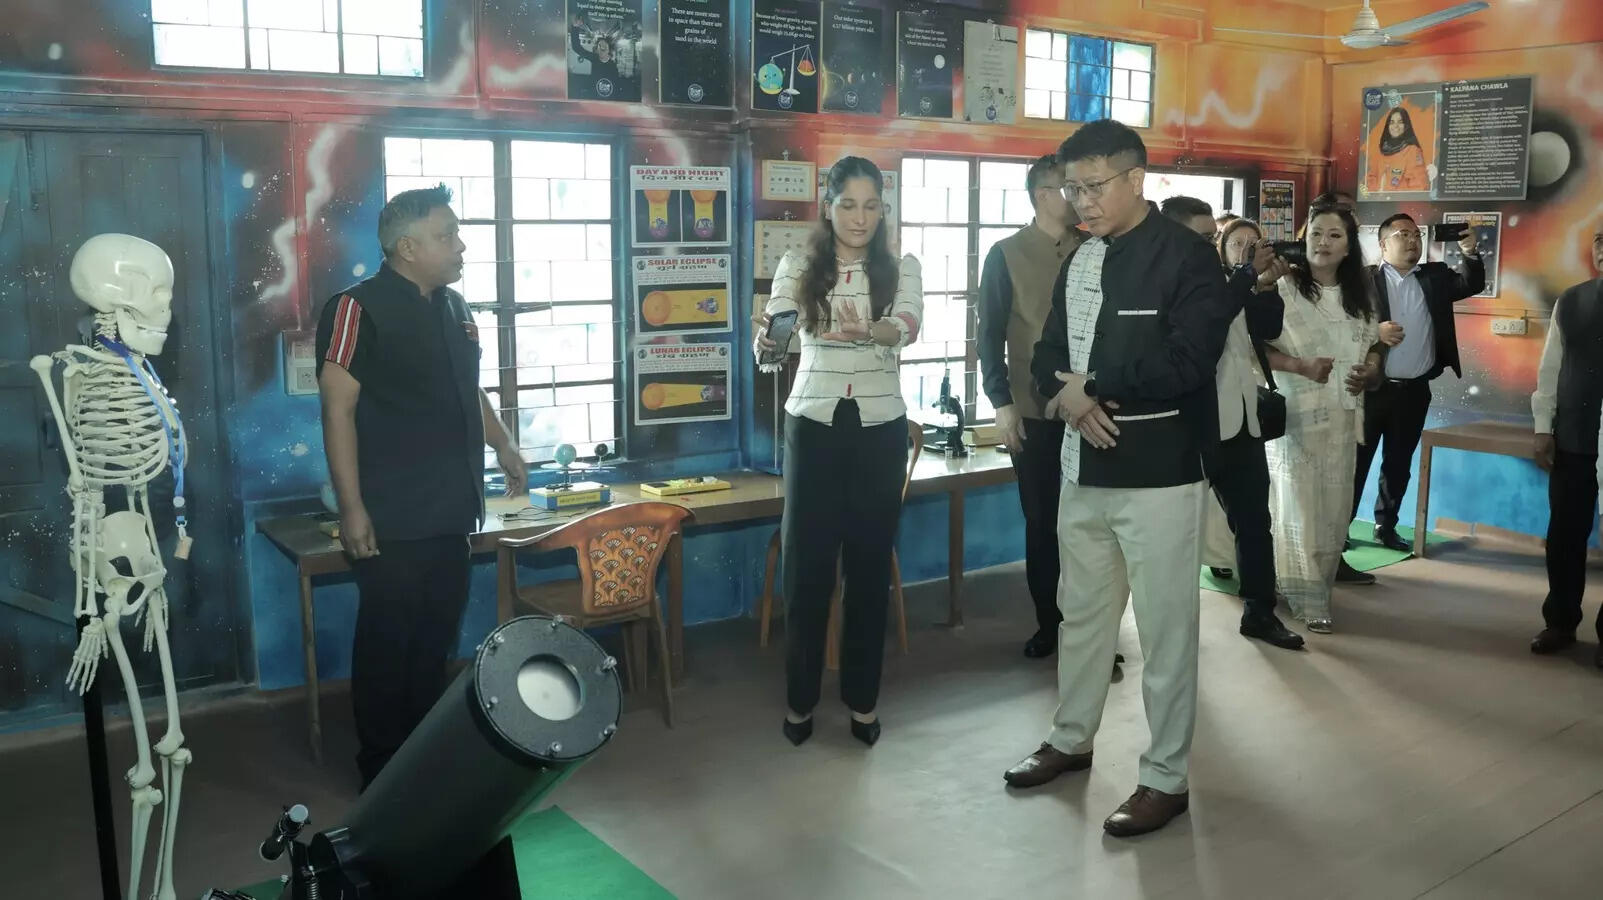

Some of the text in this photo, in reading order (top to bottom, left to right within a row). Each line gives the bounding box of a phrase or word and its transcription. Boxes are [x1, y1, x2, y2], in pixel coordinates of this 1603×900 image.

[1450, 82, 1508, 92] KALPANA CHAWLA
[688, 169, 724, 177] NIGHT
